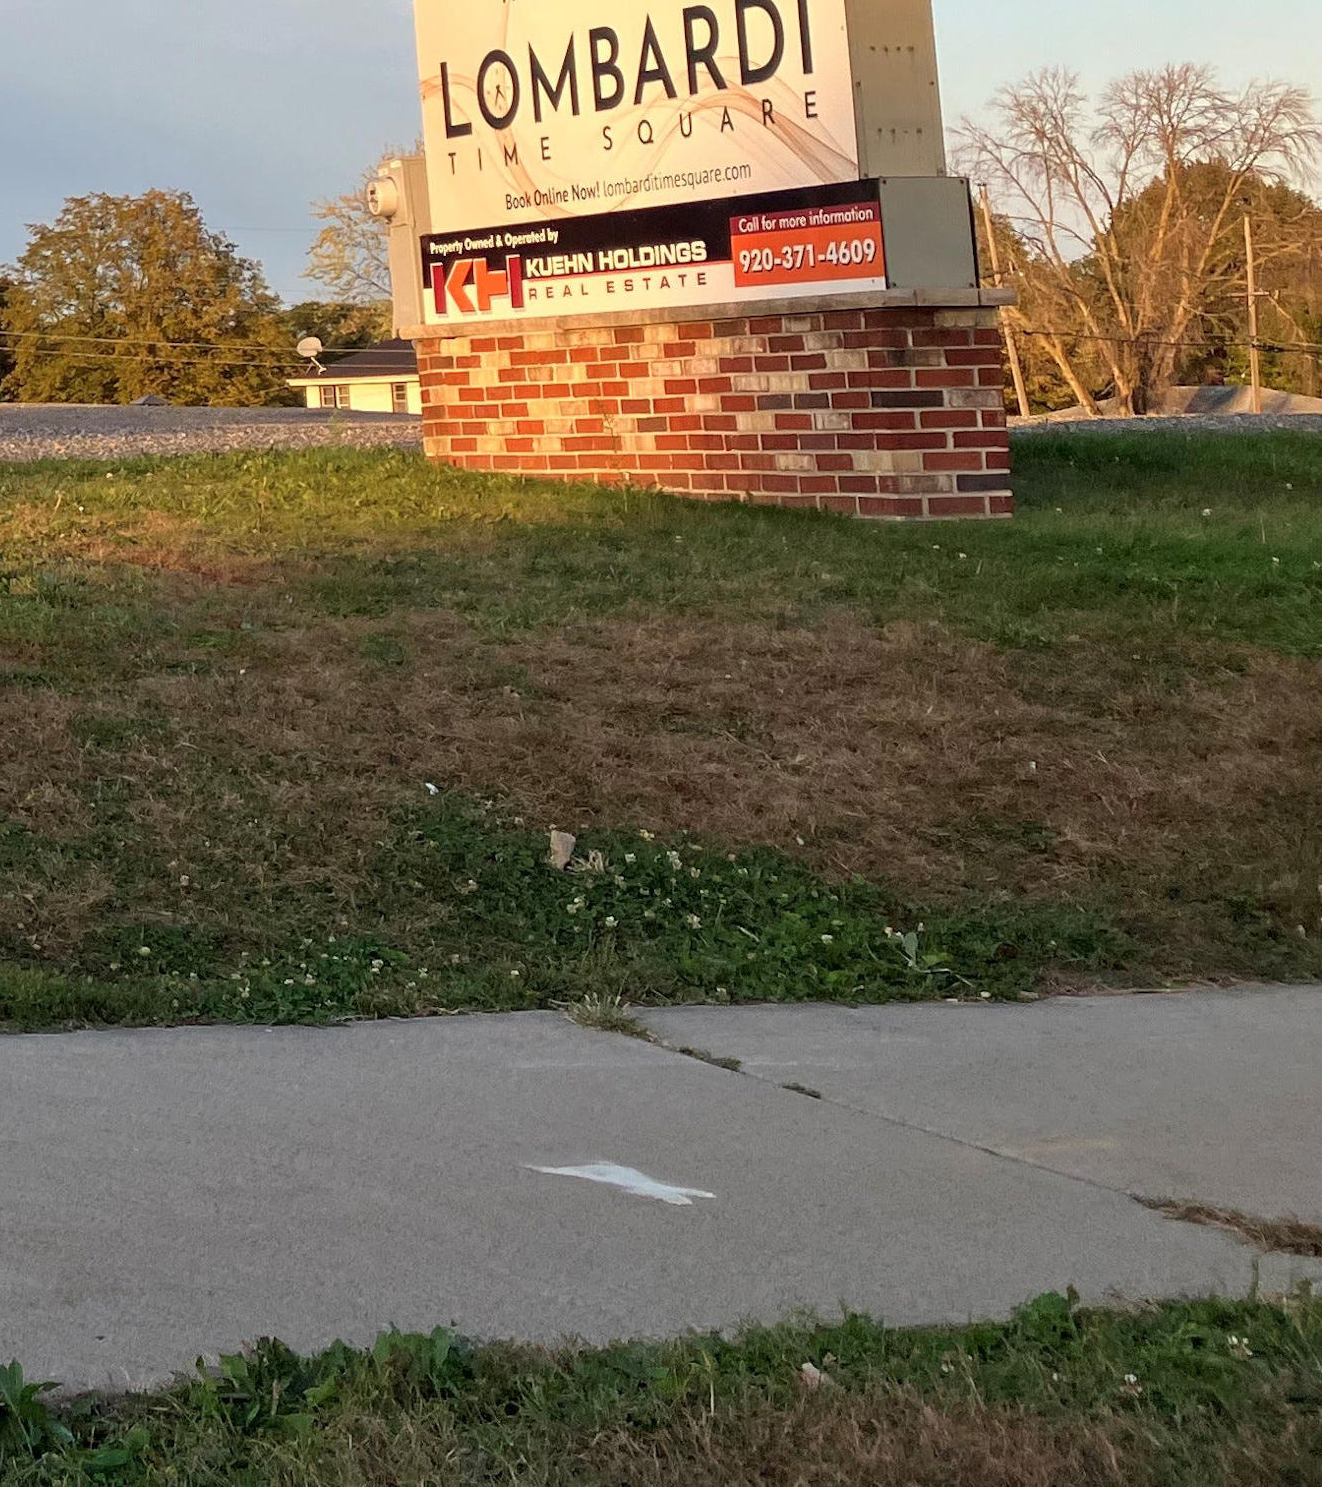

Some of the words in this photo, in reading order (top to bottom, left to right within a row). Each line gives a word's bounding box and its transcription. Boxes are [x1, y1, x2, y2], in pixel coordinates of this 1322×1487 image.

[449, 136, 552, 176] TIME
[603, 91, 819, 151] SQUARE
[506, 191, 532, 211] Book
[534, 183, 568, 206] Online
[572, 186, 600, 201] Now!
[604, 163, 751, 198] lombarditimesquare.com
[738, 216, 759, 233] Call
[761, 216, 776, 230] for
[779, 216, 806, 229] more
[808, 206, 874, 225] information
[429, 239, 463, 256] Property
[464, 235, 494, 251] Owned
[495, 235, 503, 247] &
[505, 230, 546, 246] Operated
[547, 227, 559, 245] by
[526, 251, 594, 278] KUEHN
[599, 240, 707, 271] HOLDINGS
[739, 237, 876, 273] 920-371-4609
[430, 254, 524, 314] KH
[528, 285, 589, 301] REAL
[606, 272, 707, 293] ESTATE
